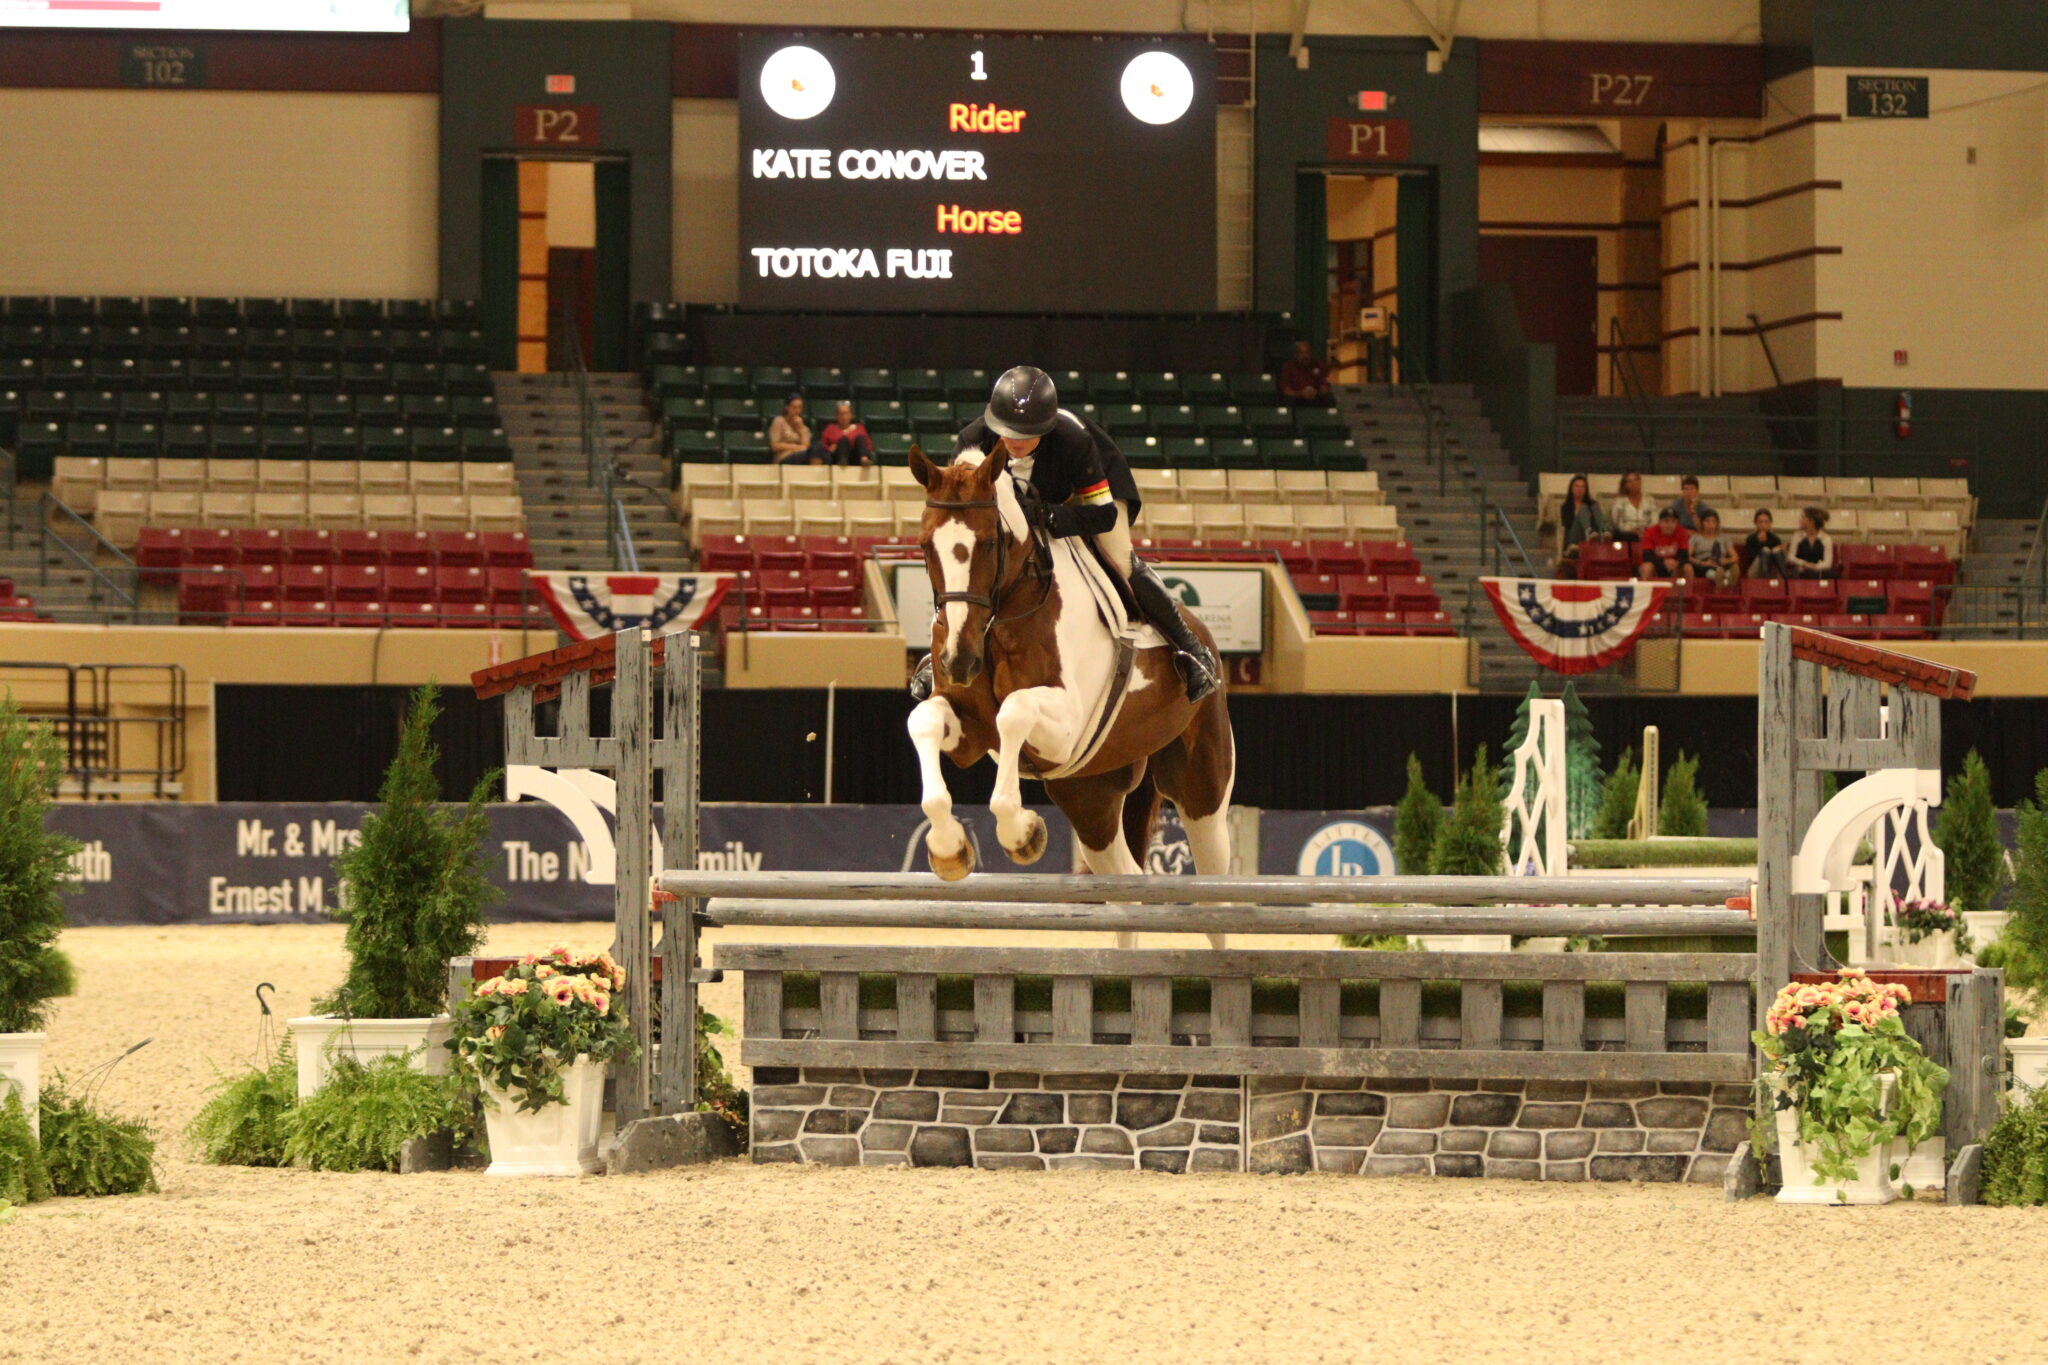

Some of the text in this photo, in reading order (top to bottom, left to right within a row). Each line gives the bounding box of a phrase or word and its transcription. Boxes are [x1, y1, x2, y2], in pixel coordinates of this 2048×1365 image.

[143, 60, 185, 84] 102
[970, 50, 988, 81] 1
[1591, 73, 1654, 105] P27
[1857, 79, 1918, 93] SECTION
[949, 102, 1027, 133] Rider
[1868, 93, 1909, 116] 132
[534, 108, 580, 141] P2
[1348, 123, 1389, 155] P1
[752, 148, 988, 180] KATE CONOVER
[936, 203, 1023, 235] Horse
[751, 247, 953, 279] TOTOKA FUJI
[237, 818, 278, 858] Mr.
[283, 822, 306, 858] &
[502, 840, 560, 883] The
[209, 875, 294, 915] Ernest
